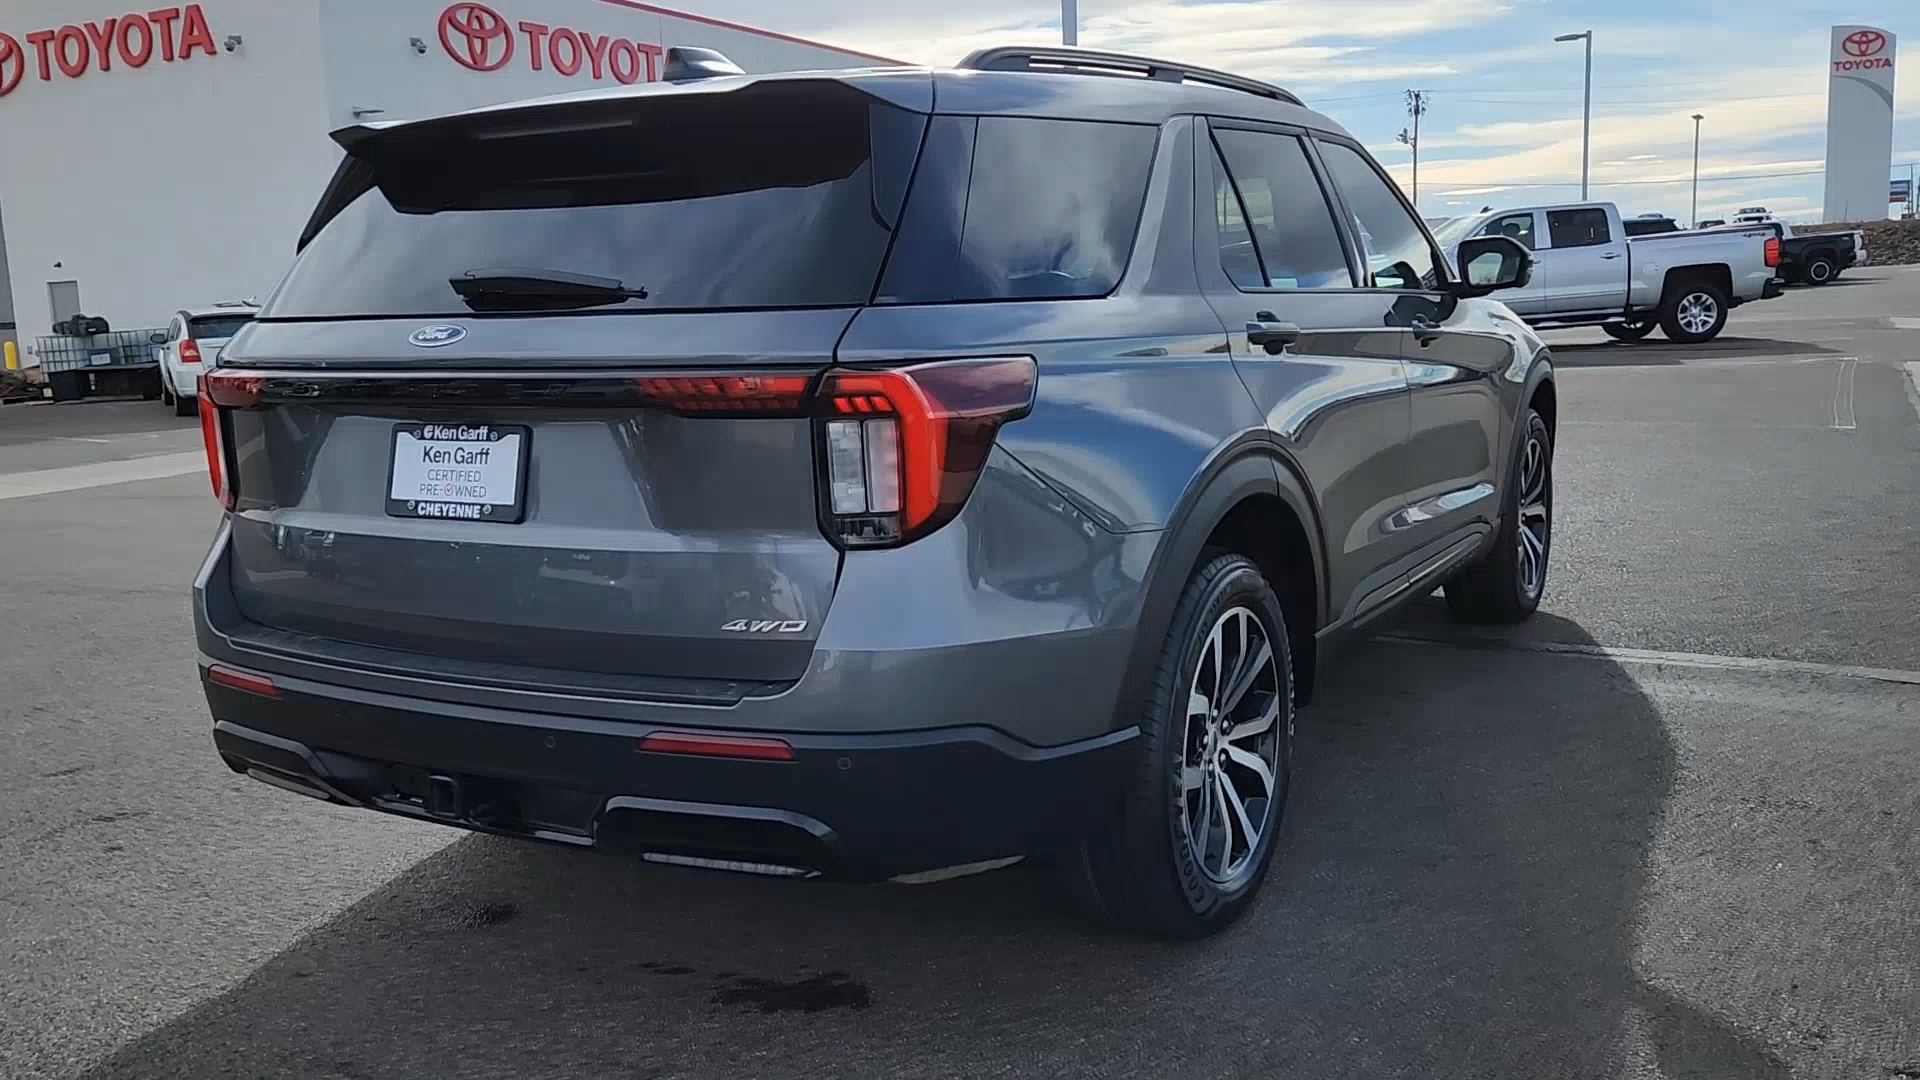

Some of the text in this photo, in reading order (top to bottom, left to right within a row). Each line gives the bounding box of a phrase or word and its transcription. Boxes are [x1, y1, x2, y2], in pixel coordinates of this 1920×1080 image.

[26, 4, 217, 81] TOYOTA
[519, 21, 672, 85] TOYOT
[1833, 58, 1893, 72] TOYOTA
[418, 328, 453, 340] Ford
[434, 425, 489, 441] Ken Garff
[422, 445, 490, 465] Ken Garff
[427, 468, 482, 483] CERTIFIED
[419, 483, 487, 499] PRE-OWNED
[417, 502, 481, 519] CHEYENNE
[720, 618, 808, 633] 4WD
